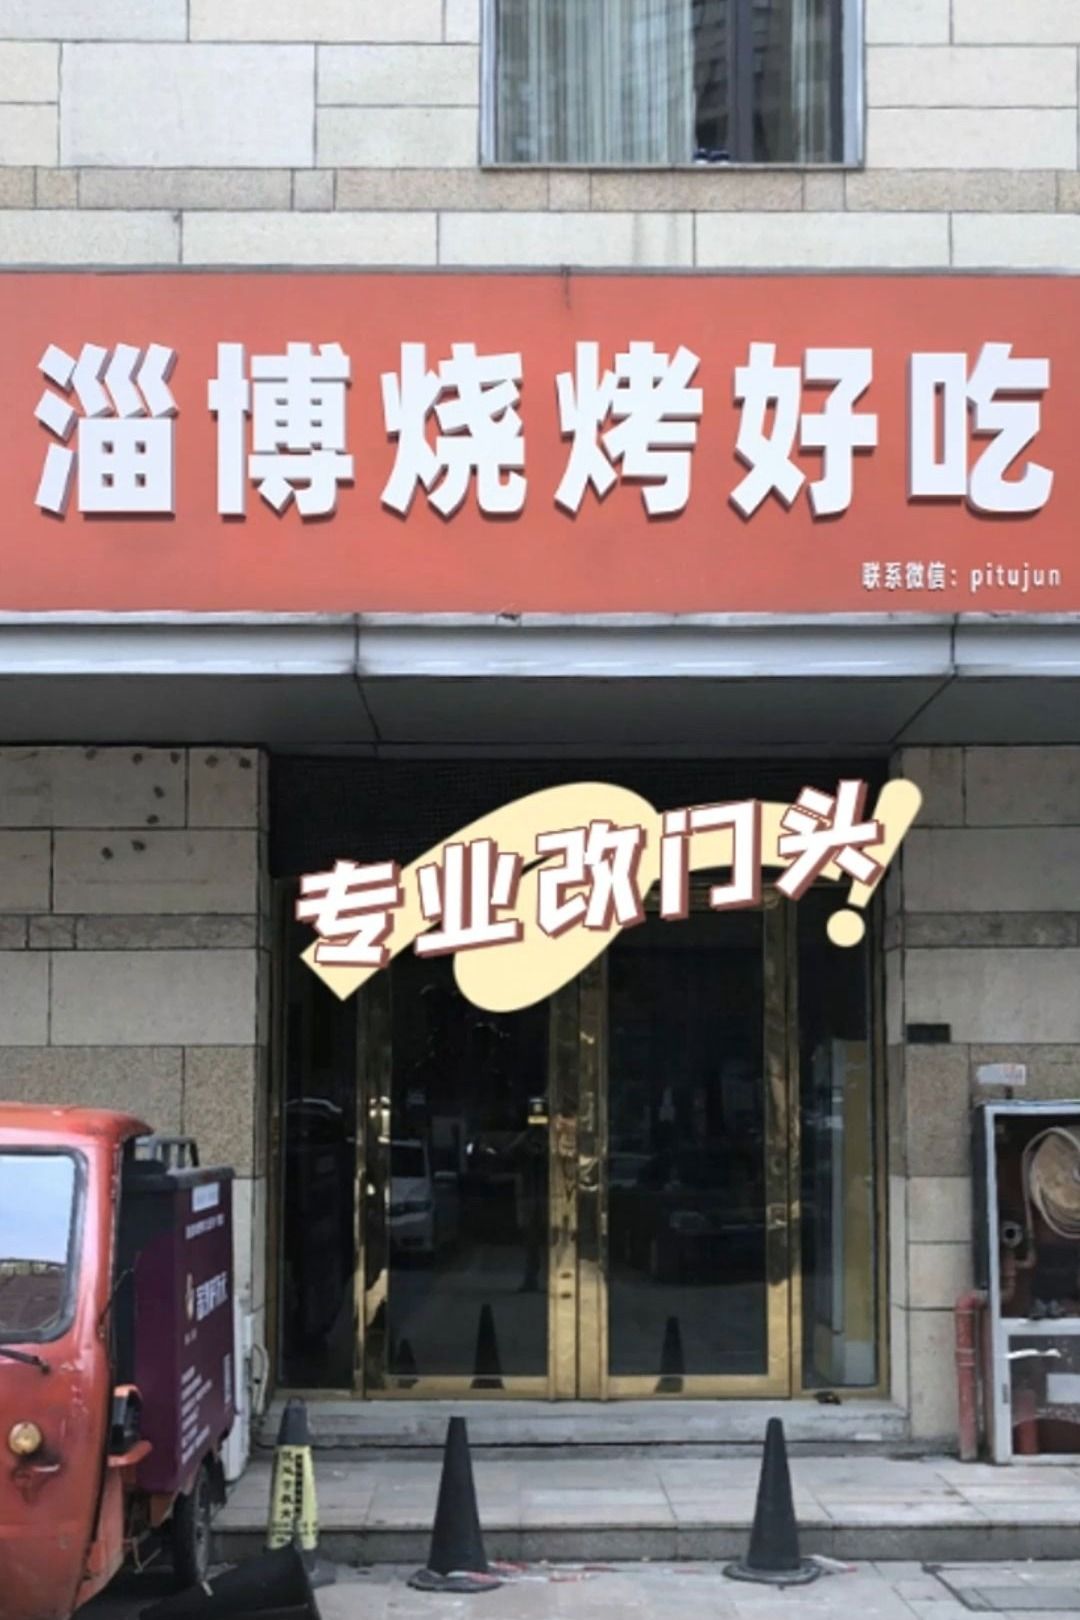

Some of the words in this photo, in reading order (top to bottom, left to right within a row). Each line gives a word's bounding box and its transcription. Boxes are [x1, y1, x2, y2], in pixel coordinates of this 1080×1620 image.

[35, 340, 1055, 518] 淄博烧烤好吃
[970, 561, 1061, 593] pitujun
